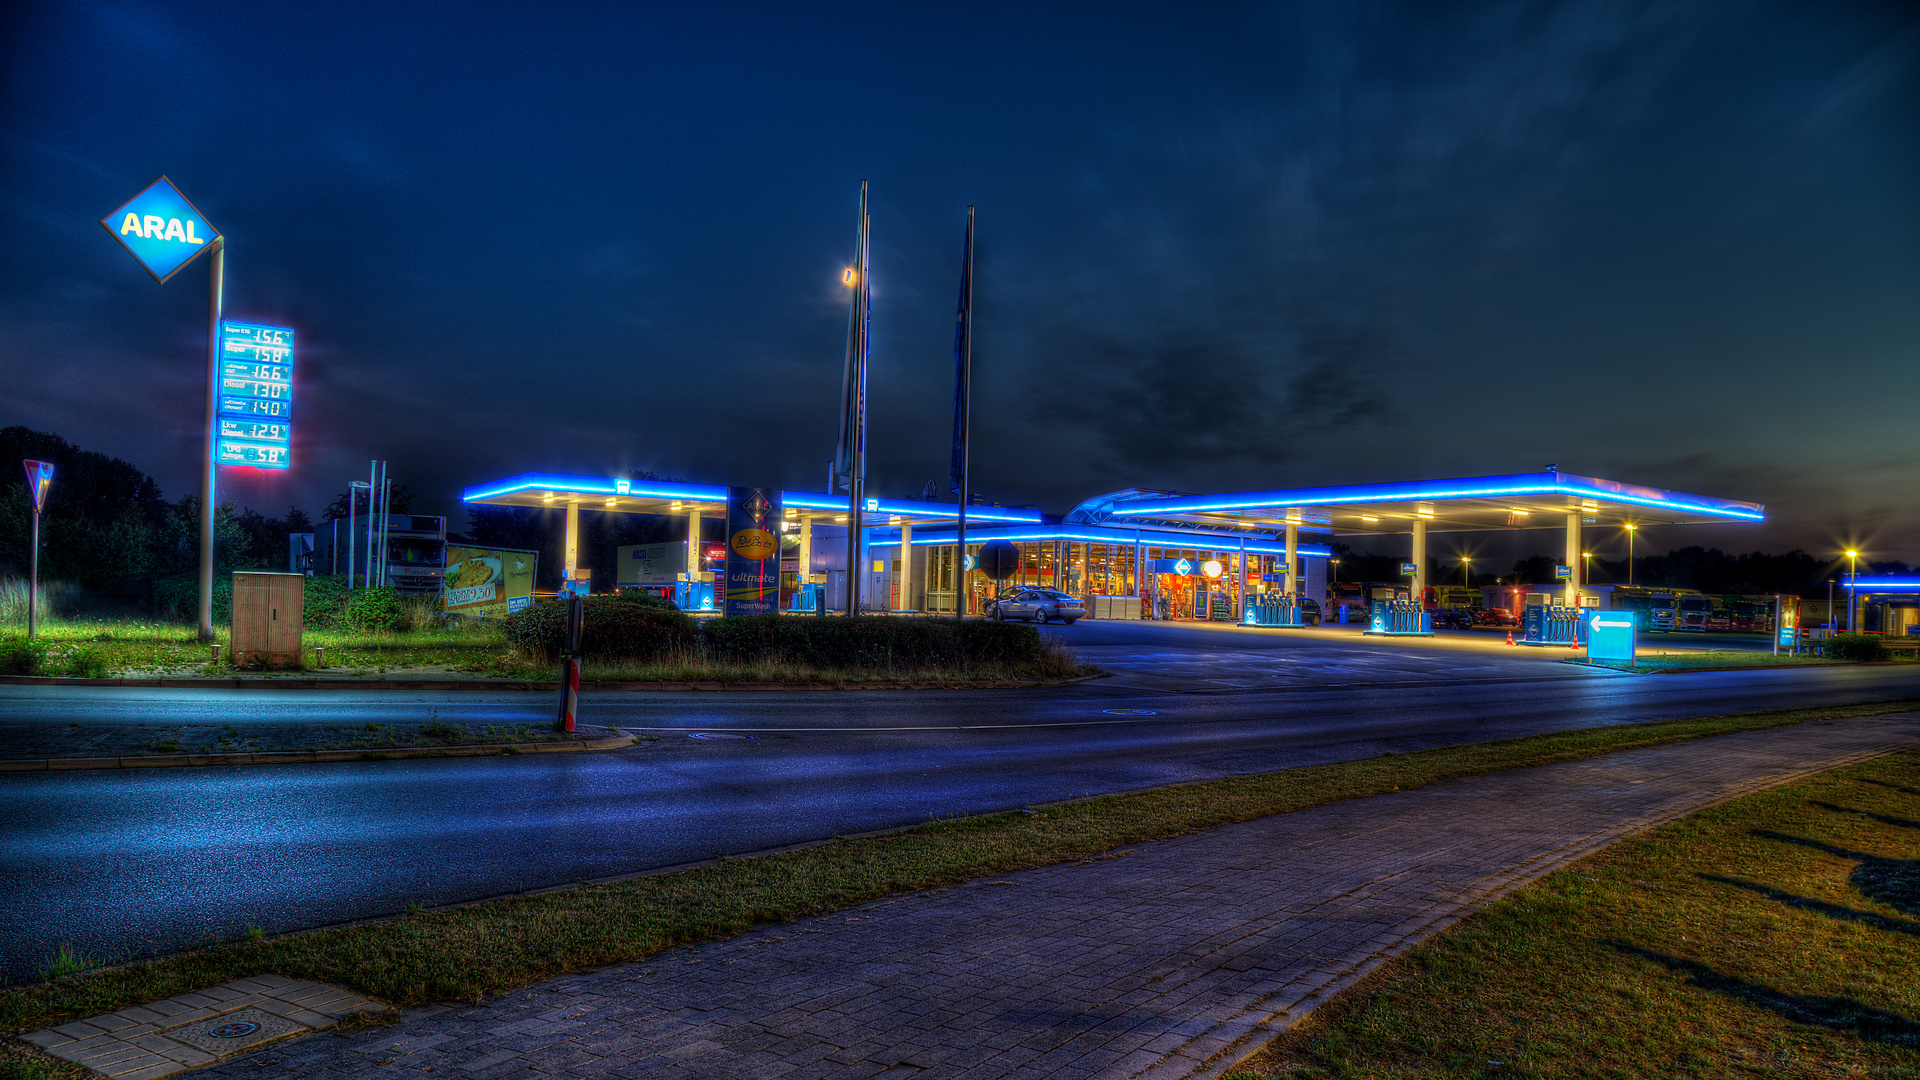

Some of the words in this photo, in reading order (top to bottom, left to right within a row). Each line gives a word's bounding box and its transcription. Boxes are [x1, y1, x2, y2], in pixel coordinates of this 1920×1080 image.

[120, 212, 204, 245] ARAL
[225, 344, 246, 353] Super
[223, 380, 246, 389] Diesel
[222, 421, 237, 429] Lkw
[222, 428, 244, 436] Diesel
[226, 445, 241, 453] LPG
[221, 452, 245, 460] Autogas
[747, 502, 768, 511] ARAL
[737, 535, 752, 547] Petit
[731, 572, 776, 583] ultimate
[736, 601, 771, 610] SuperWash
